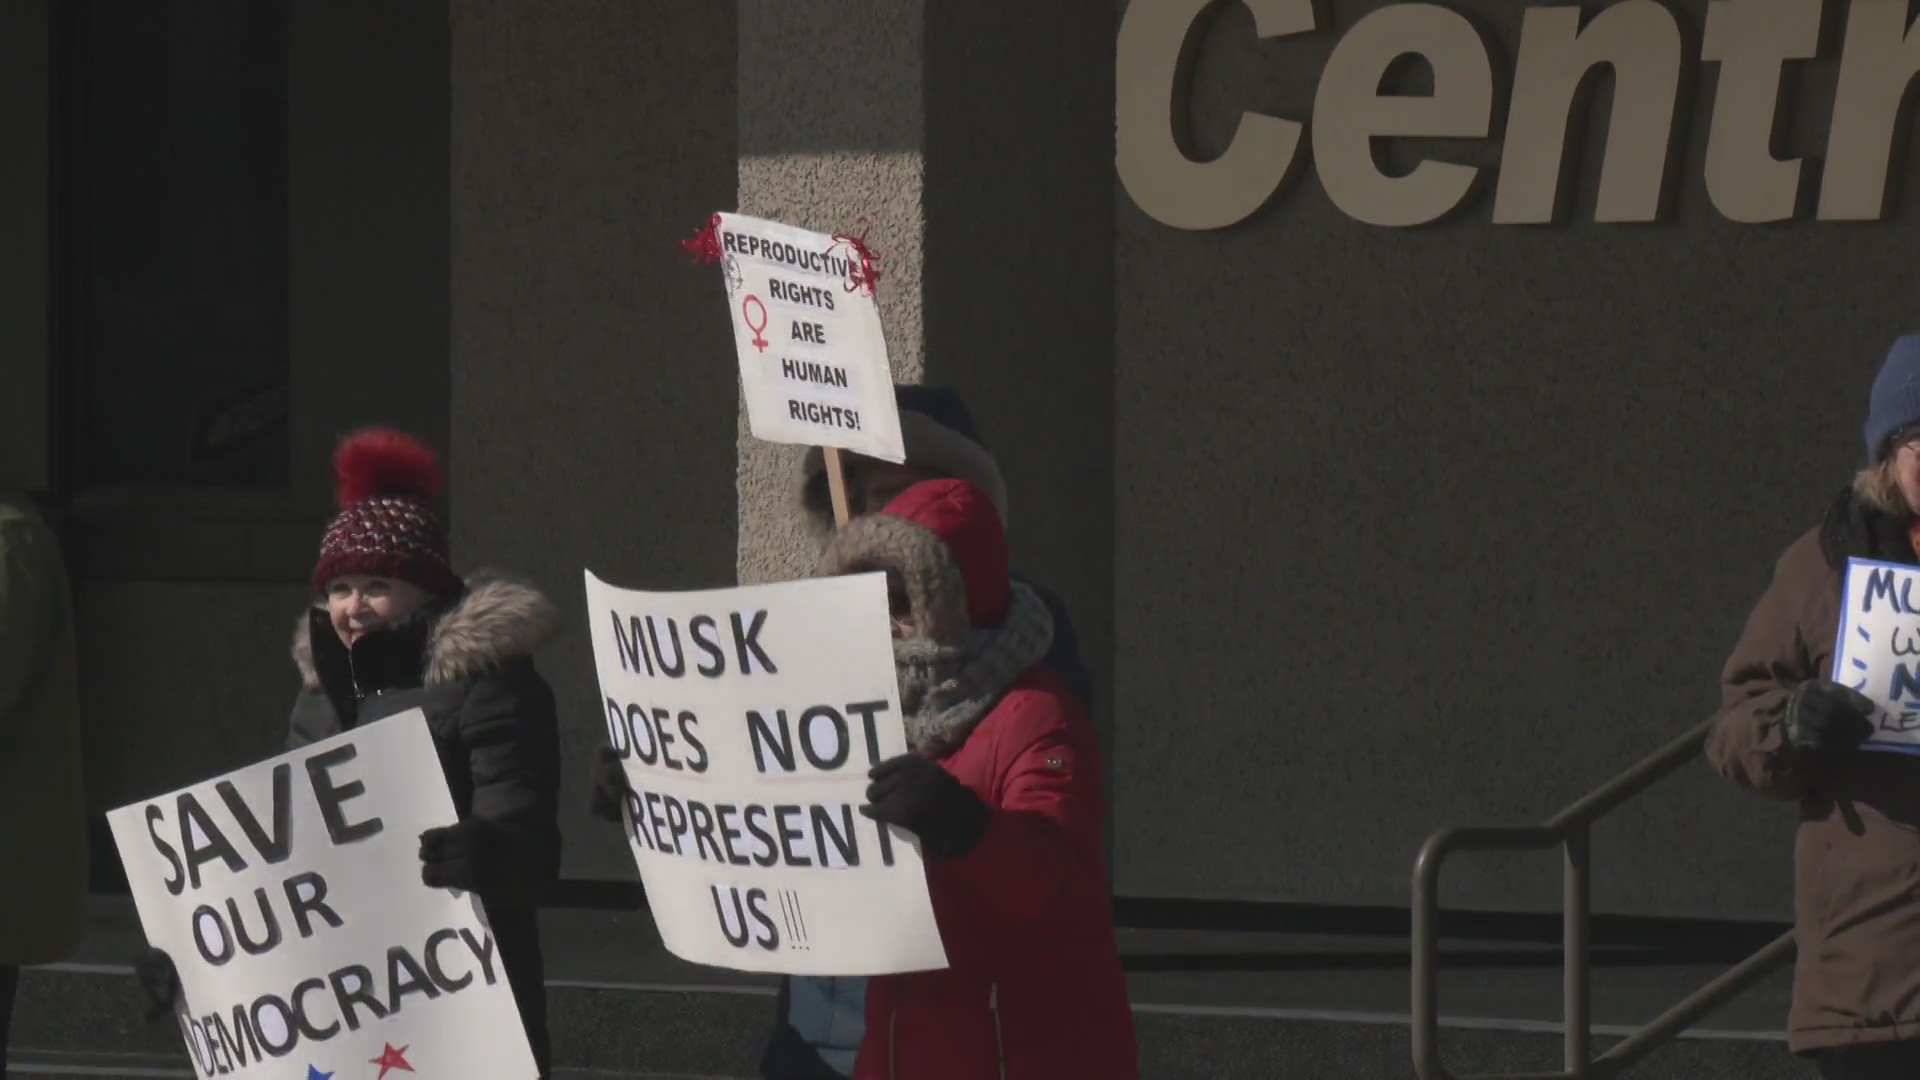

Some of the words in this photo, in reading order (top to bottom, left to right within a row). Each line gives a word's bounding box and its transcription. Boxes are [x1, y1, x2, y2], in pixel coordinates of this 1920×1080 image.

[723, 231, 862, 280] REPRODUCTIV
[769, 278, 835, 311] RIGHTS
[791, 320, 826, 344] ARE
[782, 358, 848, 388] HUMAN
[788, 399, 861, 431] RIGHTS!
[611, 609, 778, 679] MUSK
[606, 697, 709, 774] DOES
[746, 700, 889, 774] NOT
[145, 743, 384, 896] SAVE
[628, 788, 896, 868] REPRESENT
[192, 871, 344, 966] OUR
[180, 927, 498, 1078] DEMOCRACY
